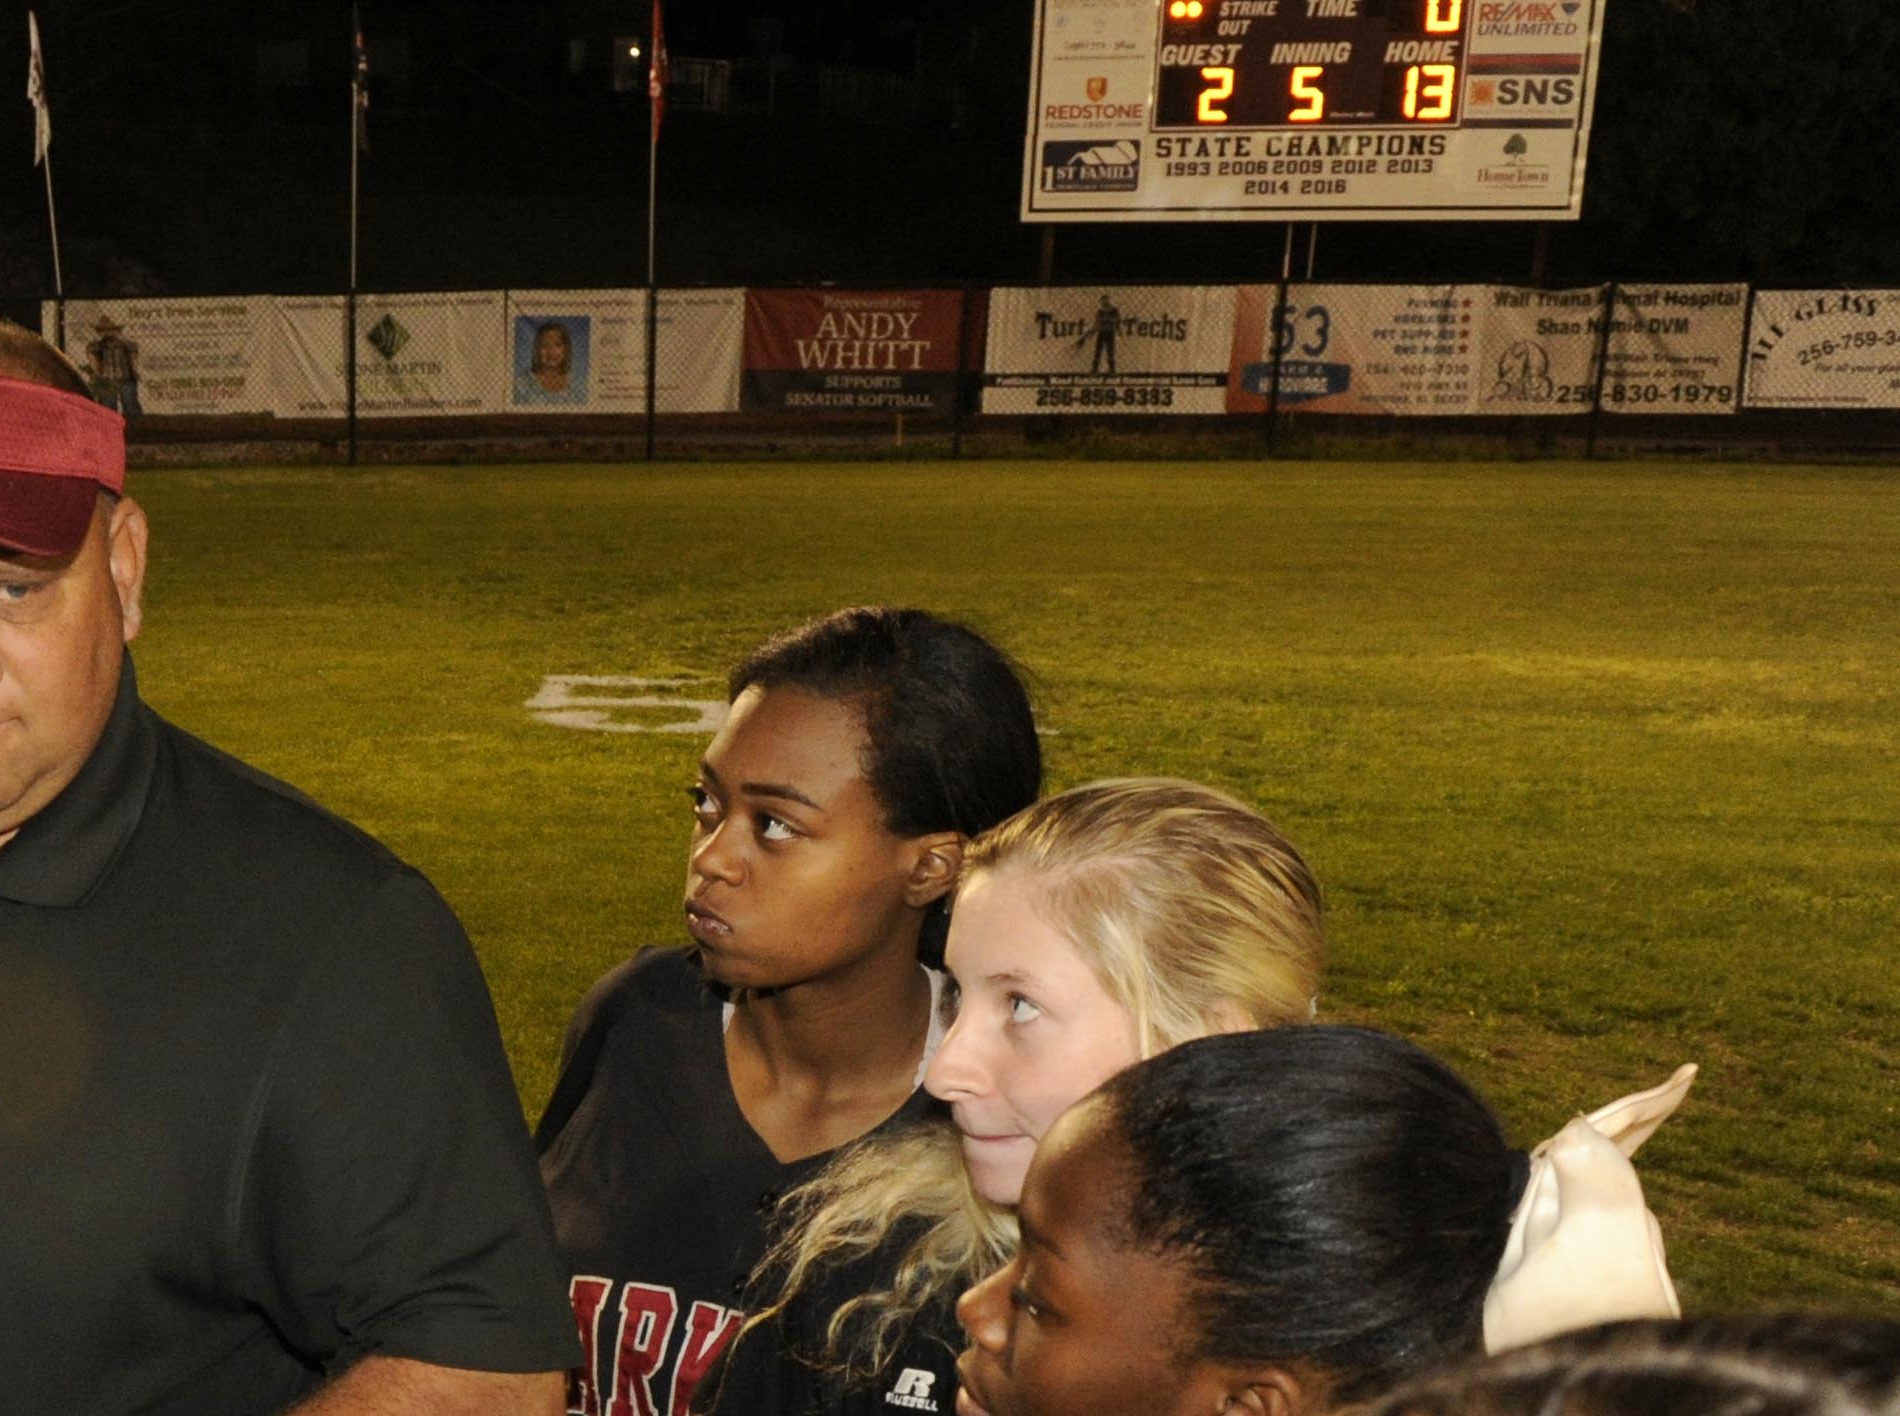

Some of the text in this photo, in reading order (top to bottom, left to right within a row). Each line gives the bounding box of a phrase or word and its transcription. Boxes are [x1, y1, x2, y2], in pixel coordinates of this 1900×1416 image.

[1219, 1, 1278, 16] STRIKE
[1306, 0, 1358, 17] TIME
[1480, 1, 1557, 22] RE/MAX
[1218, 20, 1251, 35] OUT
[1477, 22, 1578, 36] UNLIMITED
[1162, 44, 1243, 66] GUEST
[1270, 42, 1352, 65] INNING
[1384, 40, 1459, 63] HOME
[1198, 67, 1235, 121] 2
[1289, 66, 1324, 121] 5
[1403, 64, 1456, 119] 13
[1497, 78, 1575, 105] SNS
[1045, 103, 1143, 120] REDSTONE
[1156, 134, 1446, 158] STATE CHAMPIONS
[1080, 164, 1134, 180] FAMILY
[1166, 162, 1210, 177] 1993
[1331, 159, 1377, 174] 2012
[1386, 159, 1433, 174] 2013
[1244, 179, 1347, 195] 2014 2016
[1538, 292, 1592, 306] Triana
[1665, 288, 1741, 310] Hospital
[816, 312, 920, 340] ANDY
[1270, 304, 1330, 357] 53
[795, 339, 932, 370] WHITT
[1797, 330, 1900, 365] 256-759-3
[824, 375, 902, 389] SUPPORTS
[857, 393, 934, 408] SOFTBALL
[885, 1391, 939, 1413] RUSSELL
